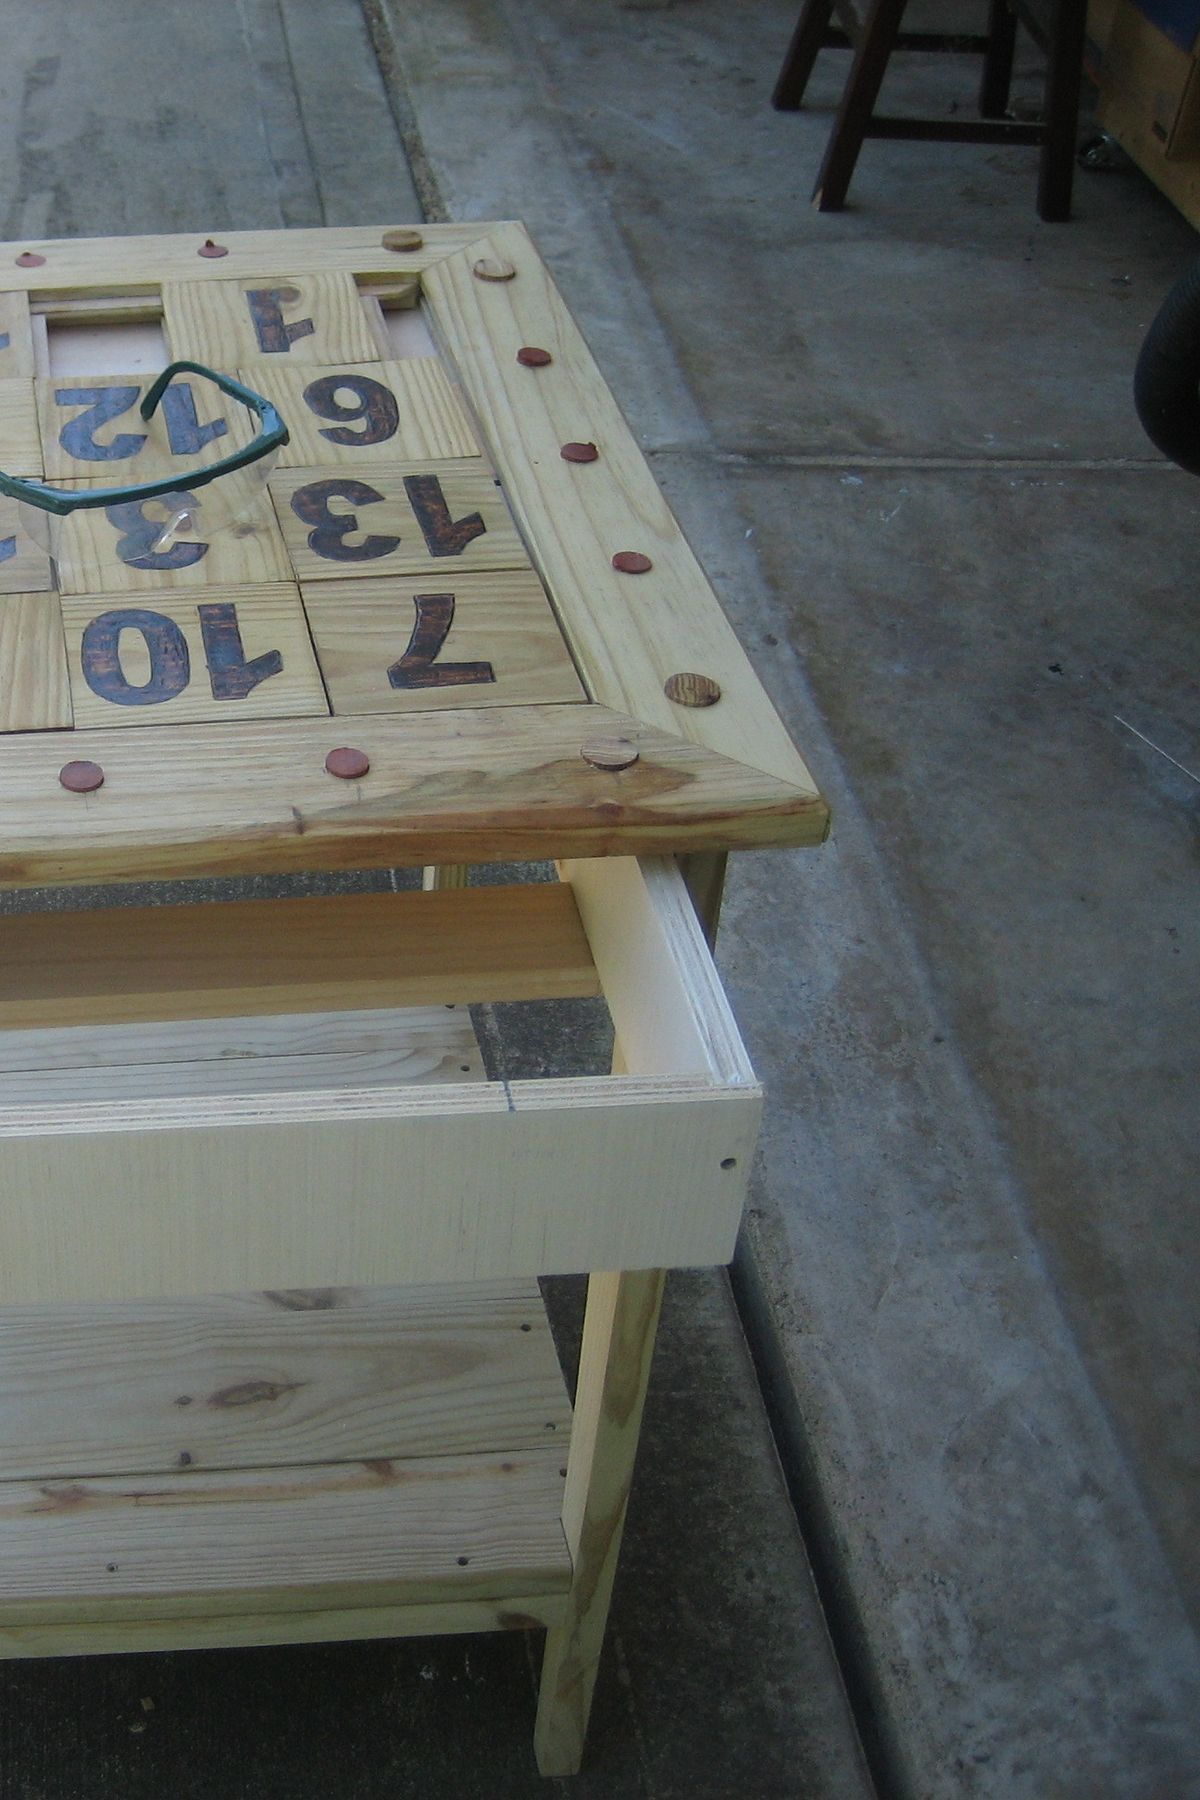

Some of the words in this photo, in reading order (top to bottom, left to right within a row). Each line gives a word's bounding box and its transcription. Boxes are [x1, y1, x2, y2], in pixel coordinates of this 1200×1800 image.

[246, 288, 314, 353] 1
[55, 382, 228, 461] 12
[303, 374, 400, 447] 6
[105, 490, 209, 570] 3
[291, 474, 486, 562] 13
[81, 603, 284, 705] 10
[387, 593, 496, 689] 7
